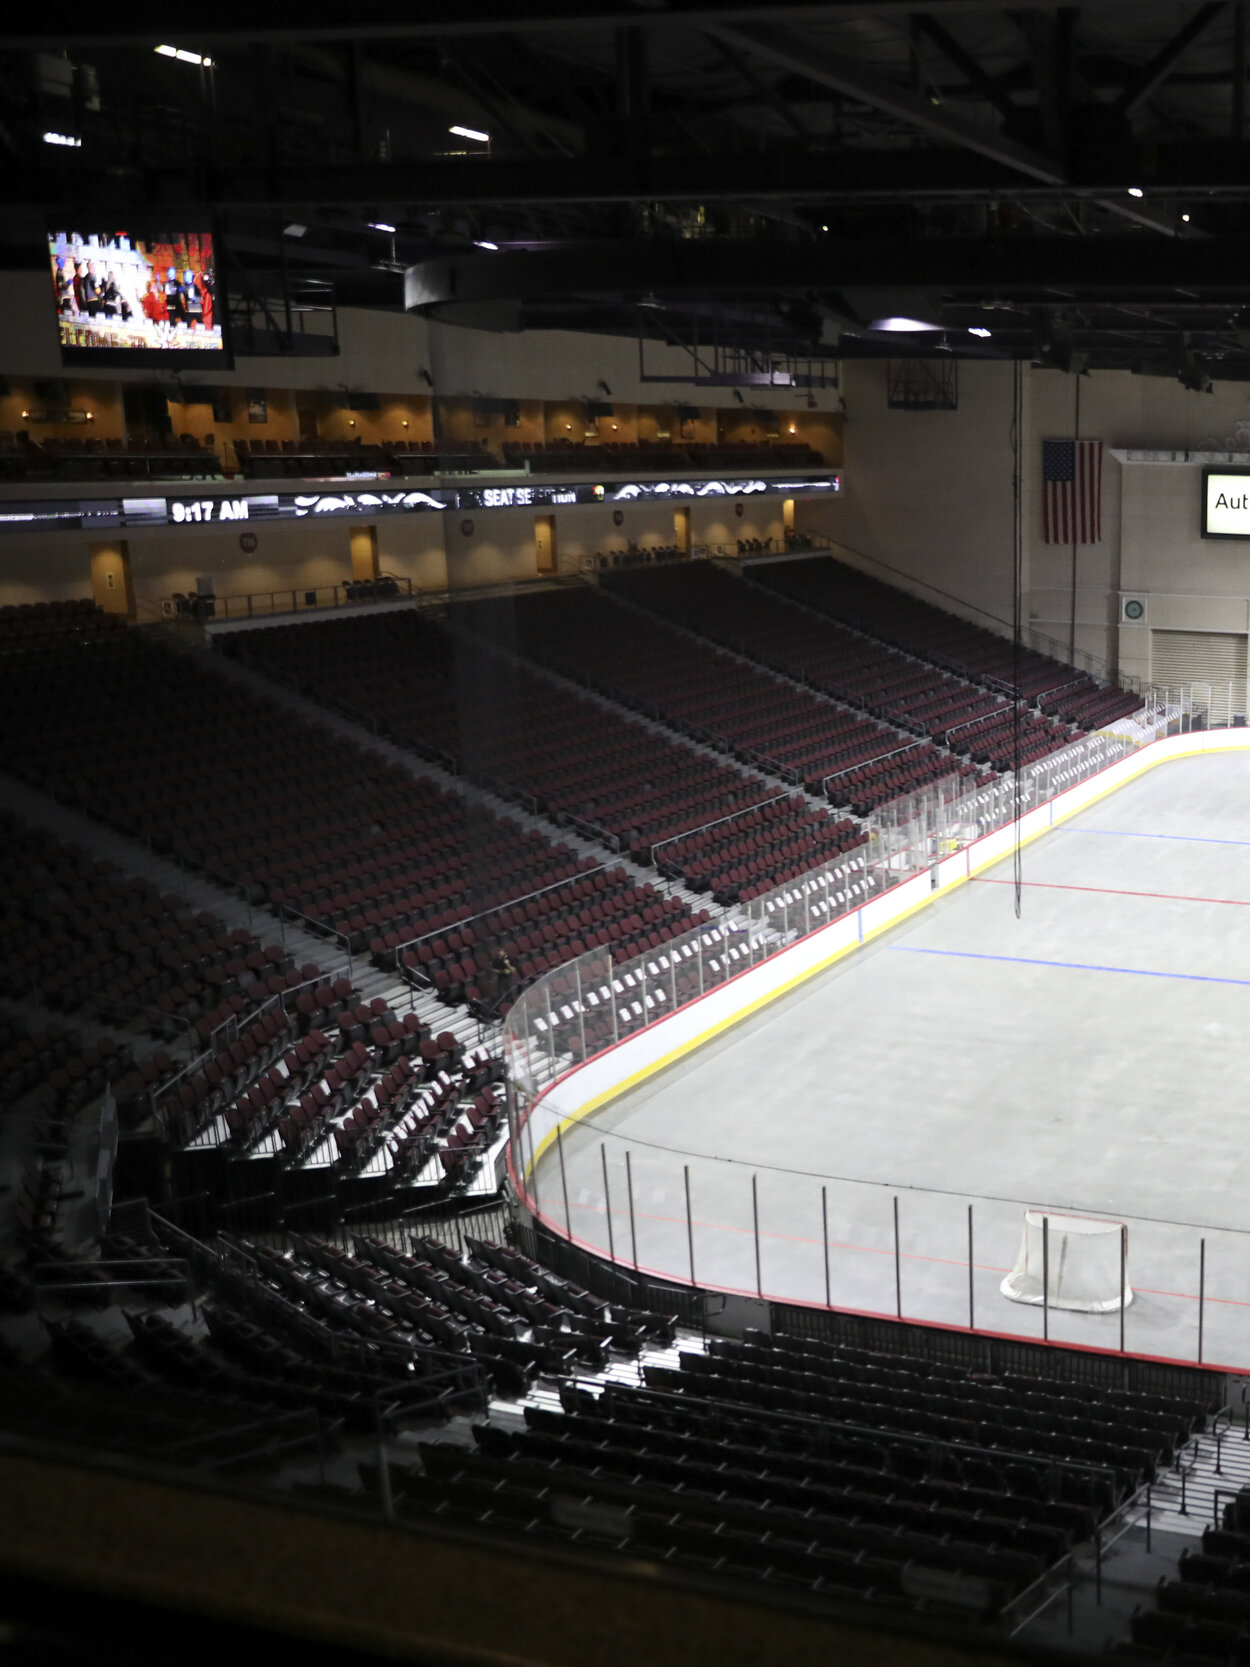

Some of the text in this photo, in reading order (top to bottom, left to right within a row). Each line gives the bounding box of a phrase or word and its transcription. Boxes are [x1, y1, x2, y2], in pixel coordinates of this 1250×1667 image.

[483, 488, 514, 507] SEAT
[172, 500, 249, 523] 9:17 AM
